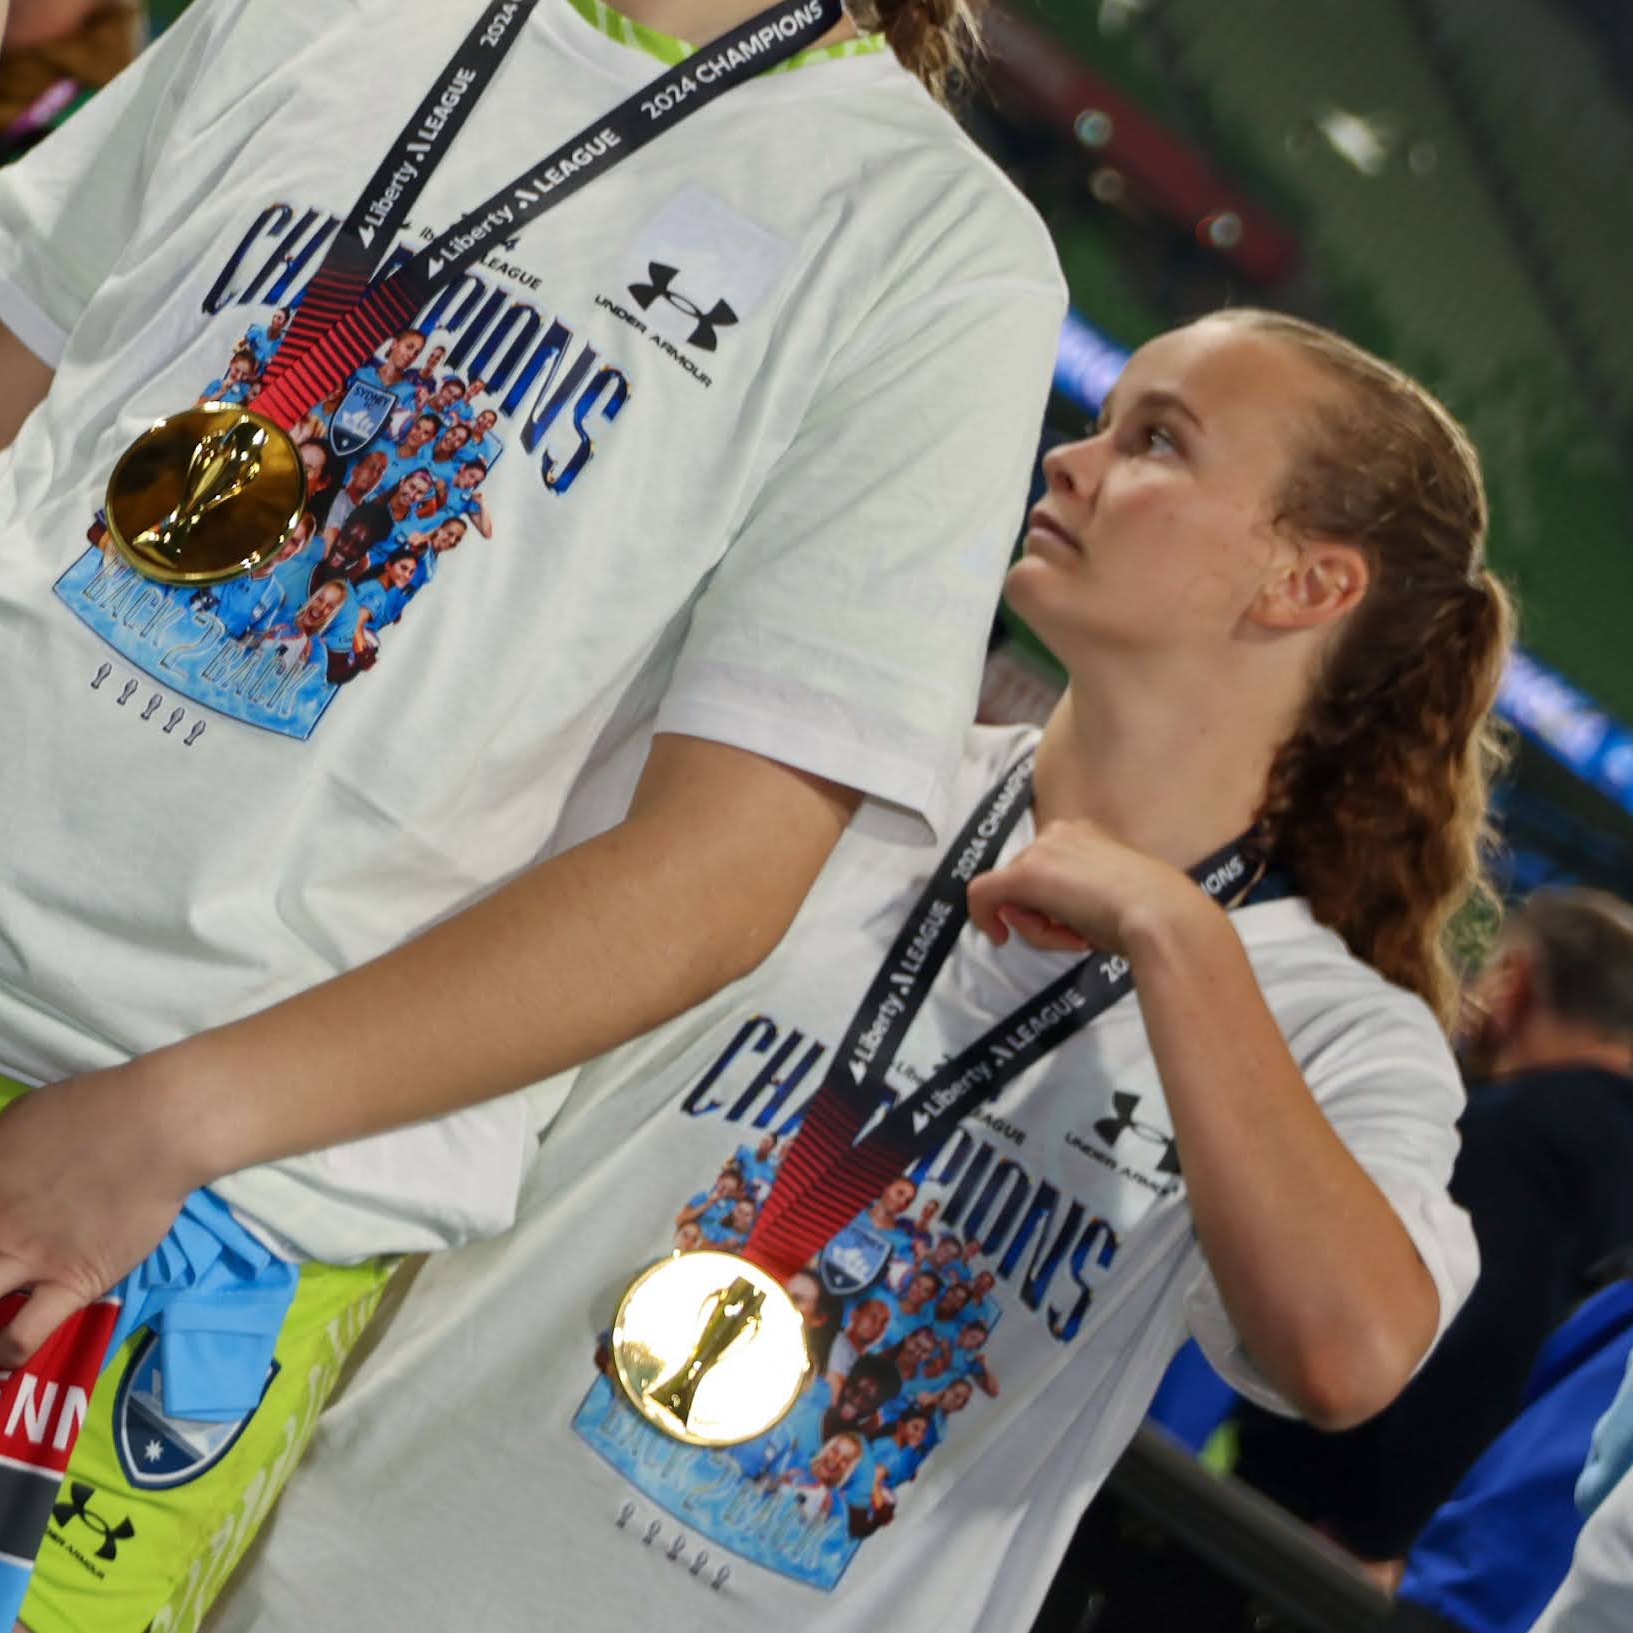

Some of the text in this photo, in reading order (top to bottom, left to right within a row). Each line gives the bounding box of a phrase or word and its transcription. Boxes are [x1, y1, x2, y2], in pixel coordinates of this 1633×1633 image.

[365, 160, 419, 229] Liberty
[426, 66, 477, 142] LEAGUE
[479, 0, 520, 48] 2024
[439, 203, 515, 263] Liberty
[533, 126, 623, 195] LEAGUE
[640, 74, 699, 122] 2024
[594, 293, 713, 389] UNDER ARMOUR
[854, 989, 908, 1065] Liberty
[901, 898, 954, 975] LEAGUE
[950, 838, 990, 885] 2024
[922, 1060, 993, 1118] Liberty
[1011, 987, 1087, 1054] LEAGUE
